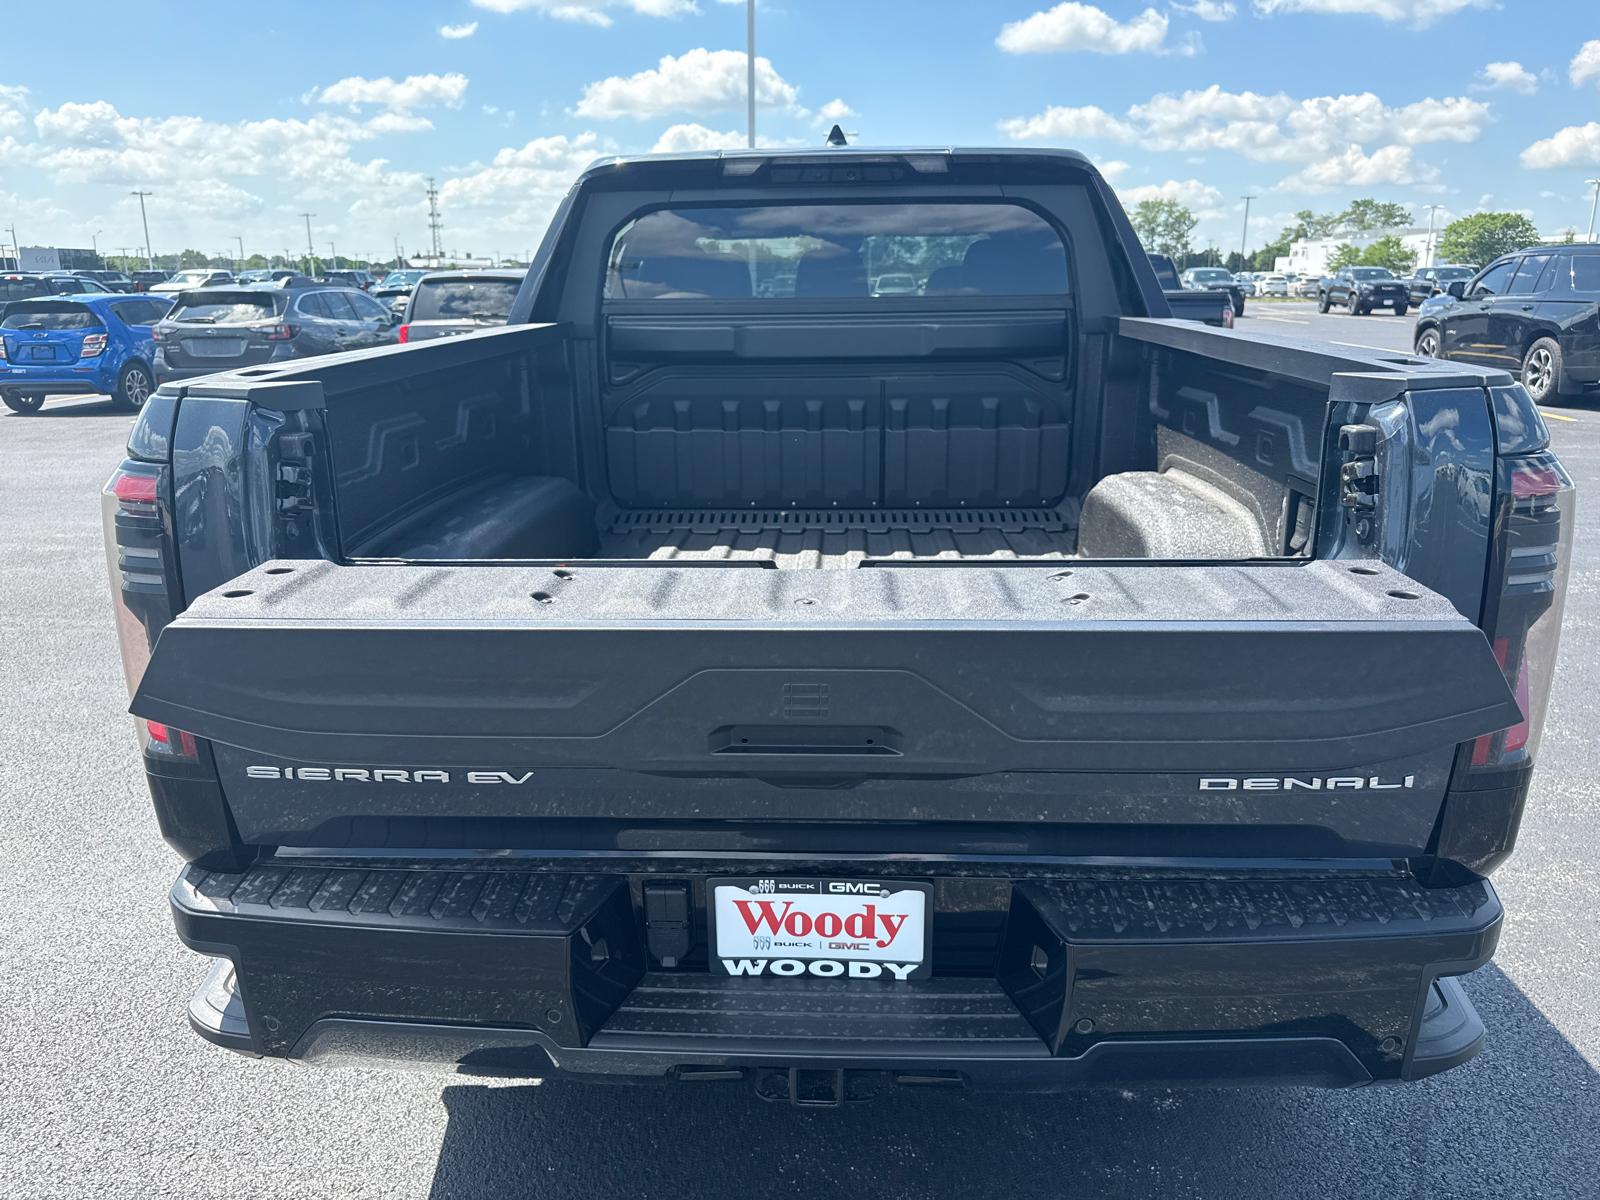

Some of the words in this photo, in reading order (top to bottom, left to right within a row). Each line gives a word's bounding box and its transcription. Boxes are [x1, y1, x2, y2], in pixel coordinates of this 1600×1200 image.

[246, 765, 450, 783] SIERRA
[467, 771, 534, 785] EV
[1199, 775, 1415, 790] DENALI
[829, 882, 881, 894] GMC
[732, 900, 909, 948] Woody
[828, 942, 870, 951] GMC
[722, 959, 919, 980] WOODY
